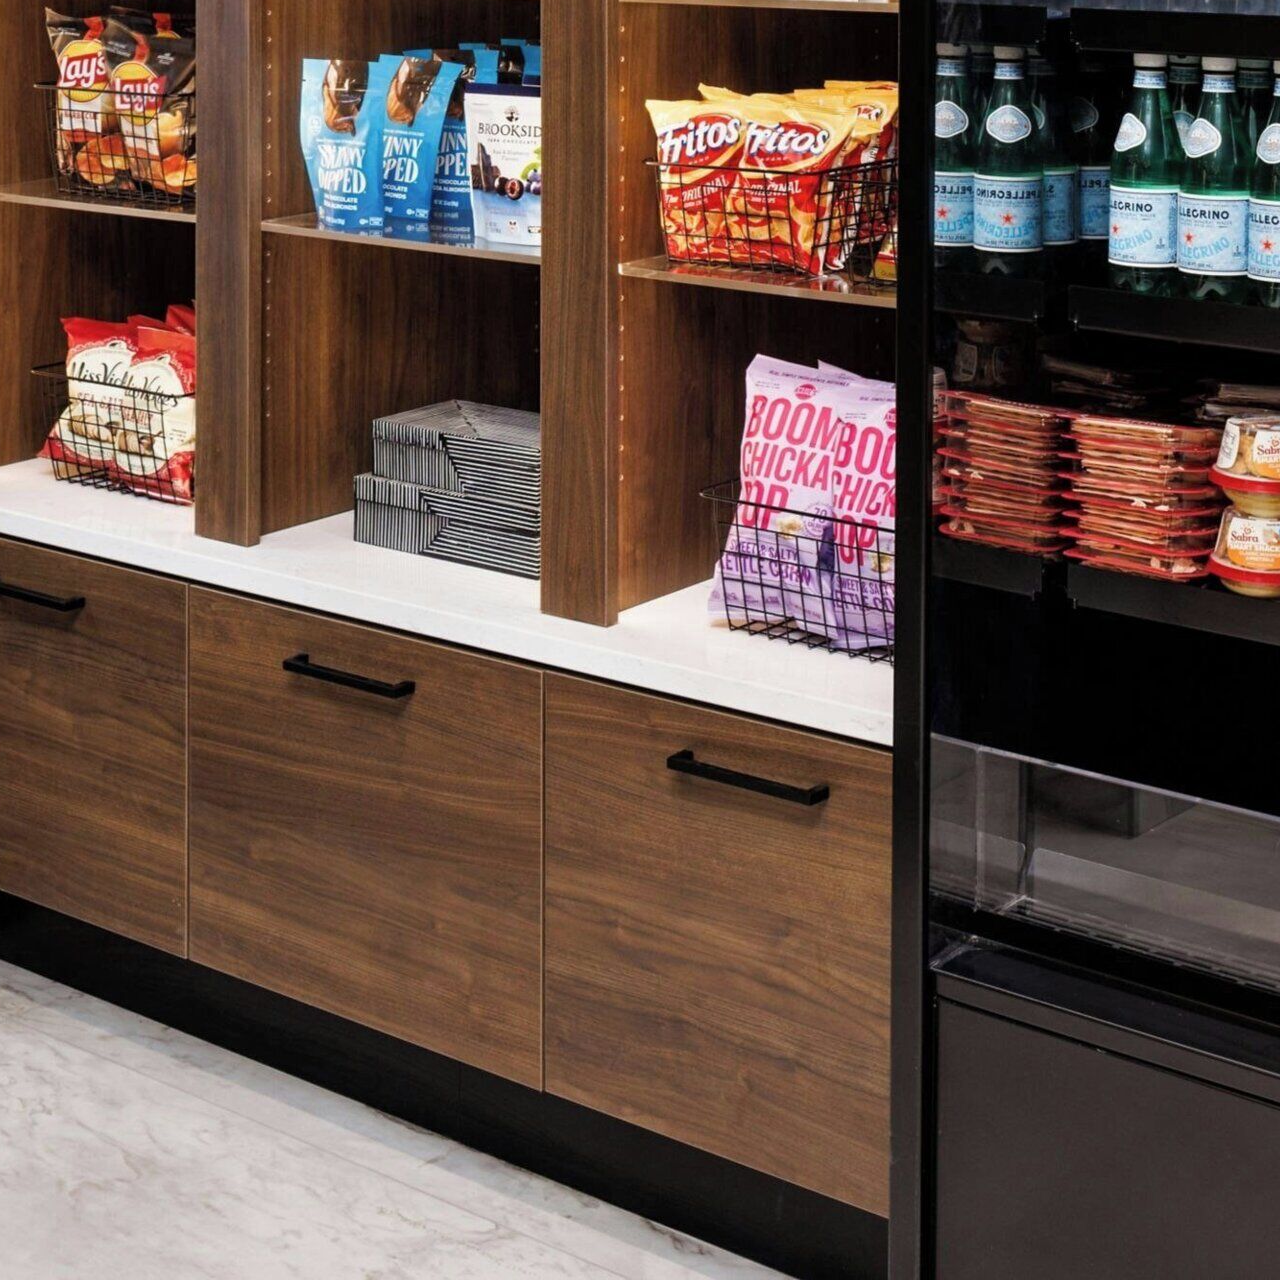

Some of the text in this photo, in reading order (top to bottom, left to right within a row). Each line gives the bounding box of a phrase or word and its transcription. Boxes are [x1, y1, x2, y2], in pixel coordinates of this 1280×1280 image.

[58, 51, 106, 87] Lay's
[115, 77, 159, 111] Lay's
[661, 118, 741, 170] Fritos
[681, 173, 730, 202] ORIGINAL
[746, 395, 838, 452] BOOM
[742, 441, 830, 491] CHICKA
[729, 538, 799, 561] SWEET SALTY
[1230, 531, 1259, 543] Sabra
[723, 553, 812, 586] ETTLE CORN
